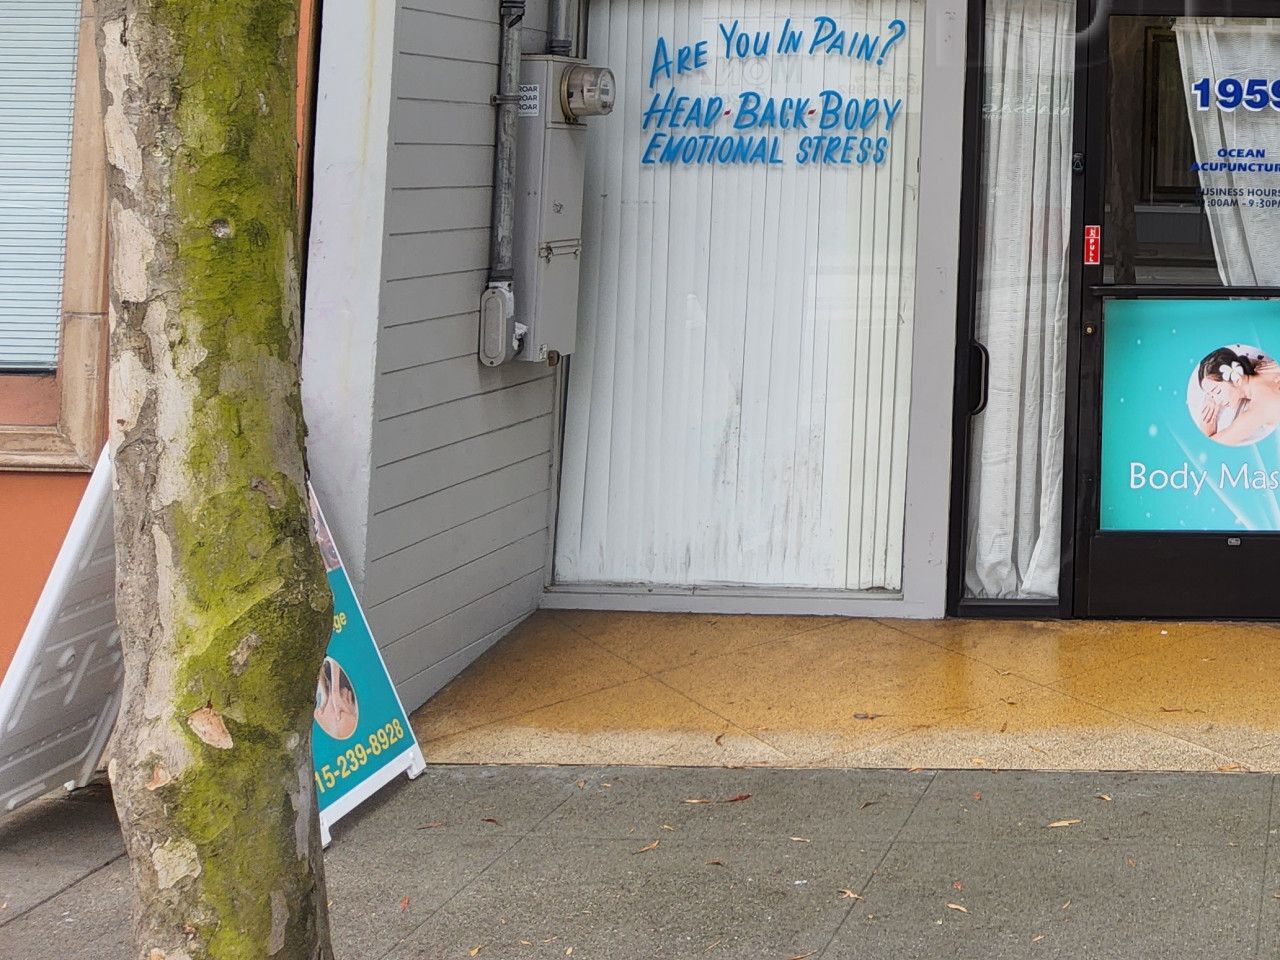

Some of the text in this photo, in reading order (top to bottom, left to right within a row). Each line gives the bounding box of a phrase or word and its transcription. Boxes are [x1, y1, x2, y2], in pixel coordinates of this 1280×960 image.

[649, 37, 709, 89] ARE
[718, 20, 769, 60] YOU
[808, 16, 907, 68] PAIN?
[641, 133, 888, 165] EMOTIONAL STRESS
[1217, 148, 1266, 159] OCEAN
[1129, 462, 1208, 496] Body
[313, 717, 404, 796] 15-239-8928
